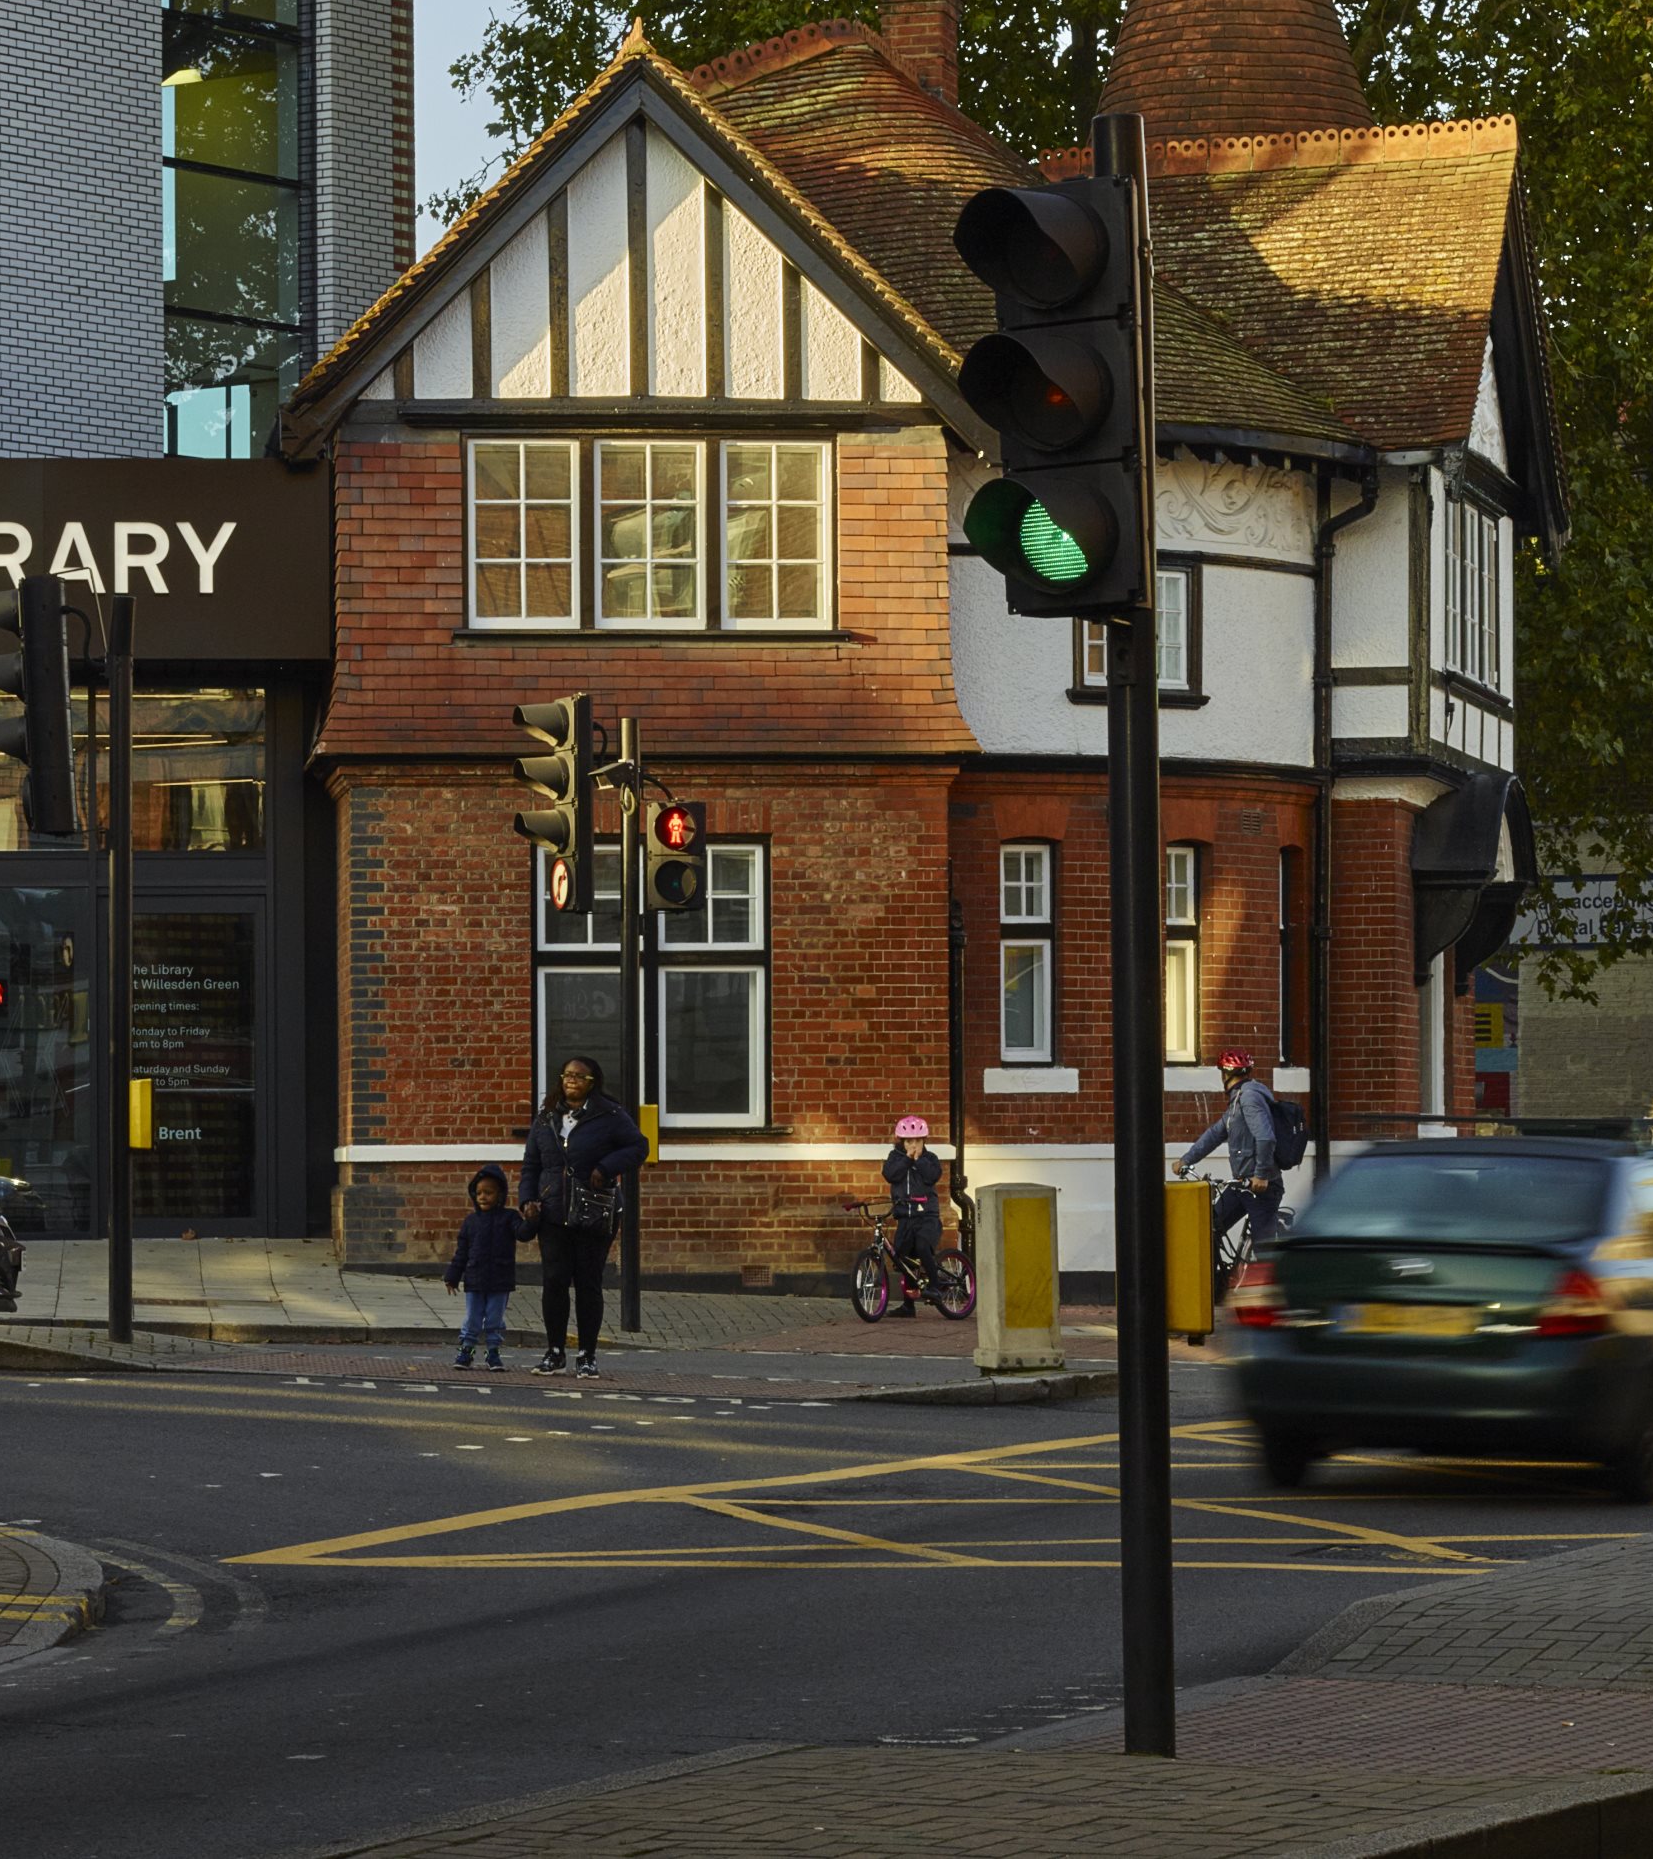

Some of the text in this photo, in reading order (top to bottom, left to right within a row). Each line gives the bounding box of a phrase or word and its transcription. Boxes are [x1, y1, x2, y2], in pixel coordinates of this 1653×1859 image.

[133, 964, 194, 977] he Library
[141, 979, 200, 990] Willesden
[203, 978, 240, 990] Green
[133, 1002, 199, 1012] pening times:
[167, 1028, 178, 1036] to
[179, 1027, 210, 1038] Friday
[150, 1040, 161, 1049] to
[162, 1039, 185, 1050] 8pm
[133, 1064, 230, 1075] aturday and Sunday
[155, 1077, 189, 1088] to 5pm
[158, 1126, 202, 1140] Brent
